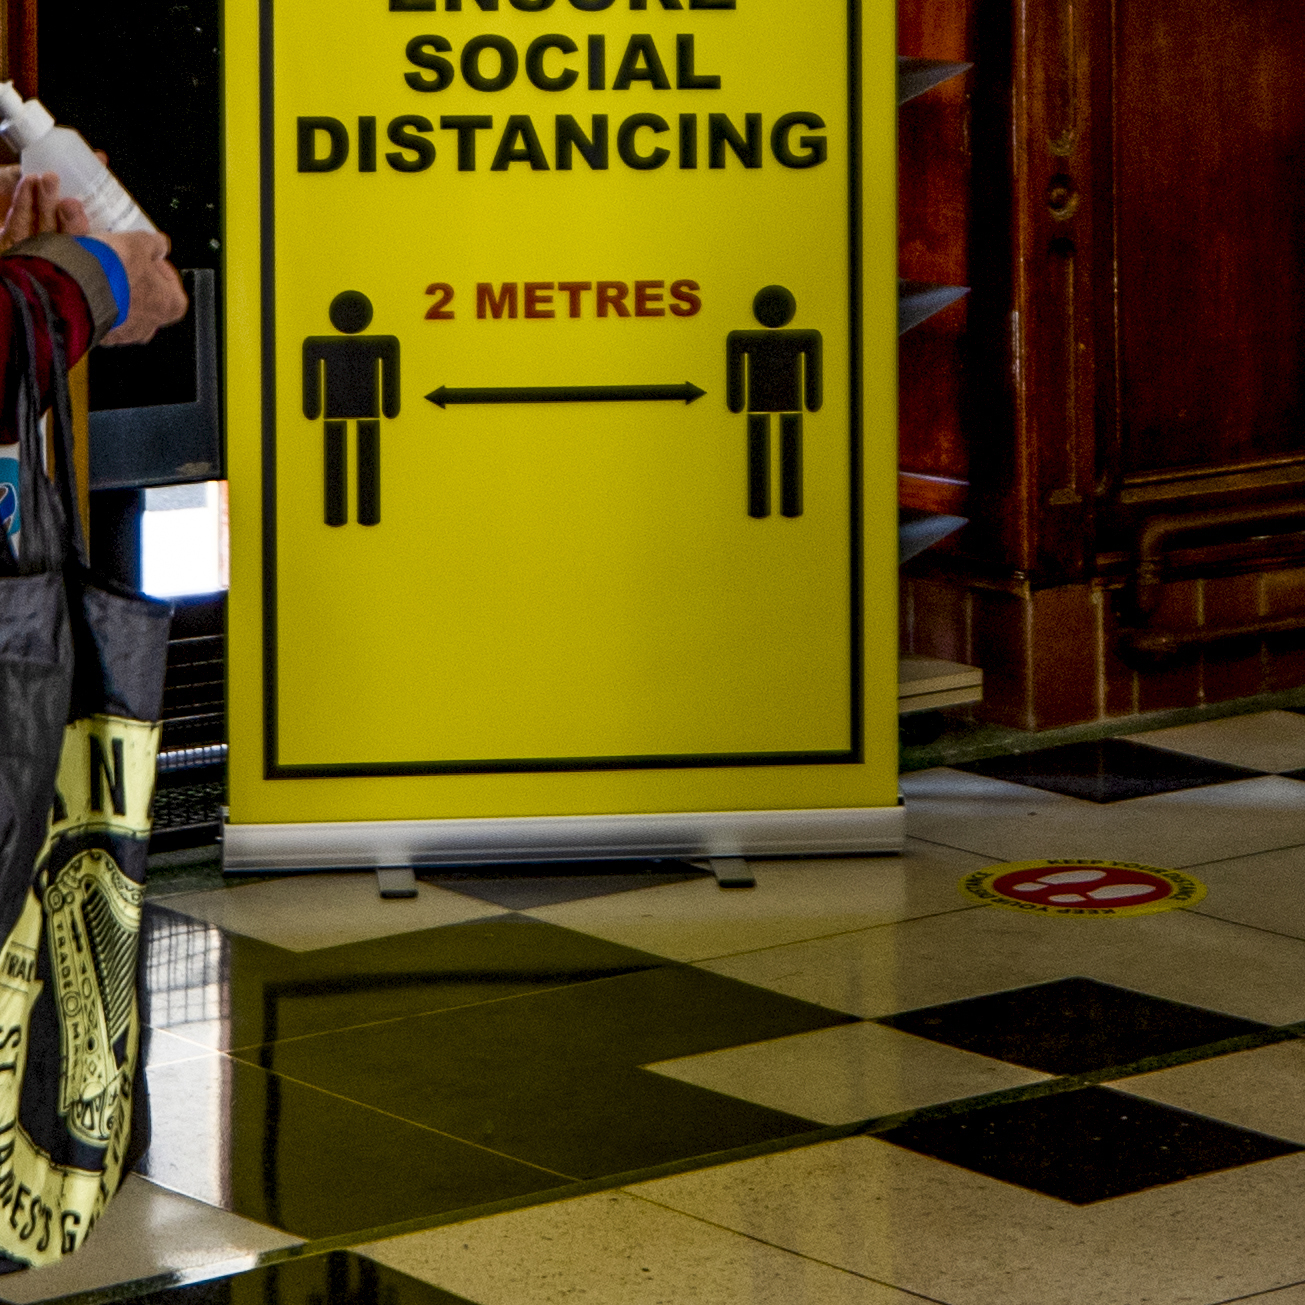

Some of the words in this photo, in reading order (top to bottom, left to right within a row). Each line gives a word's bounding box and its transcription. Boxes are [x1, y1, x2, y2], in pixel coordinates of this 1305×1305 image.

[404, 34, 721, 93] SOCIAL
[297, 112, 827, 173] DISTANCING
[424, 283, 455, 321] 2
[476, 279, 702, 319] METRES
